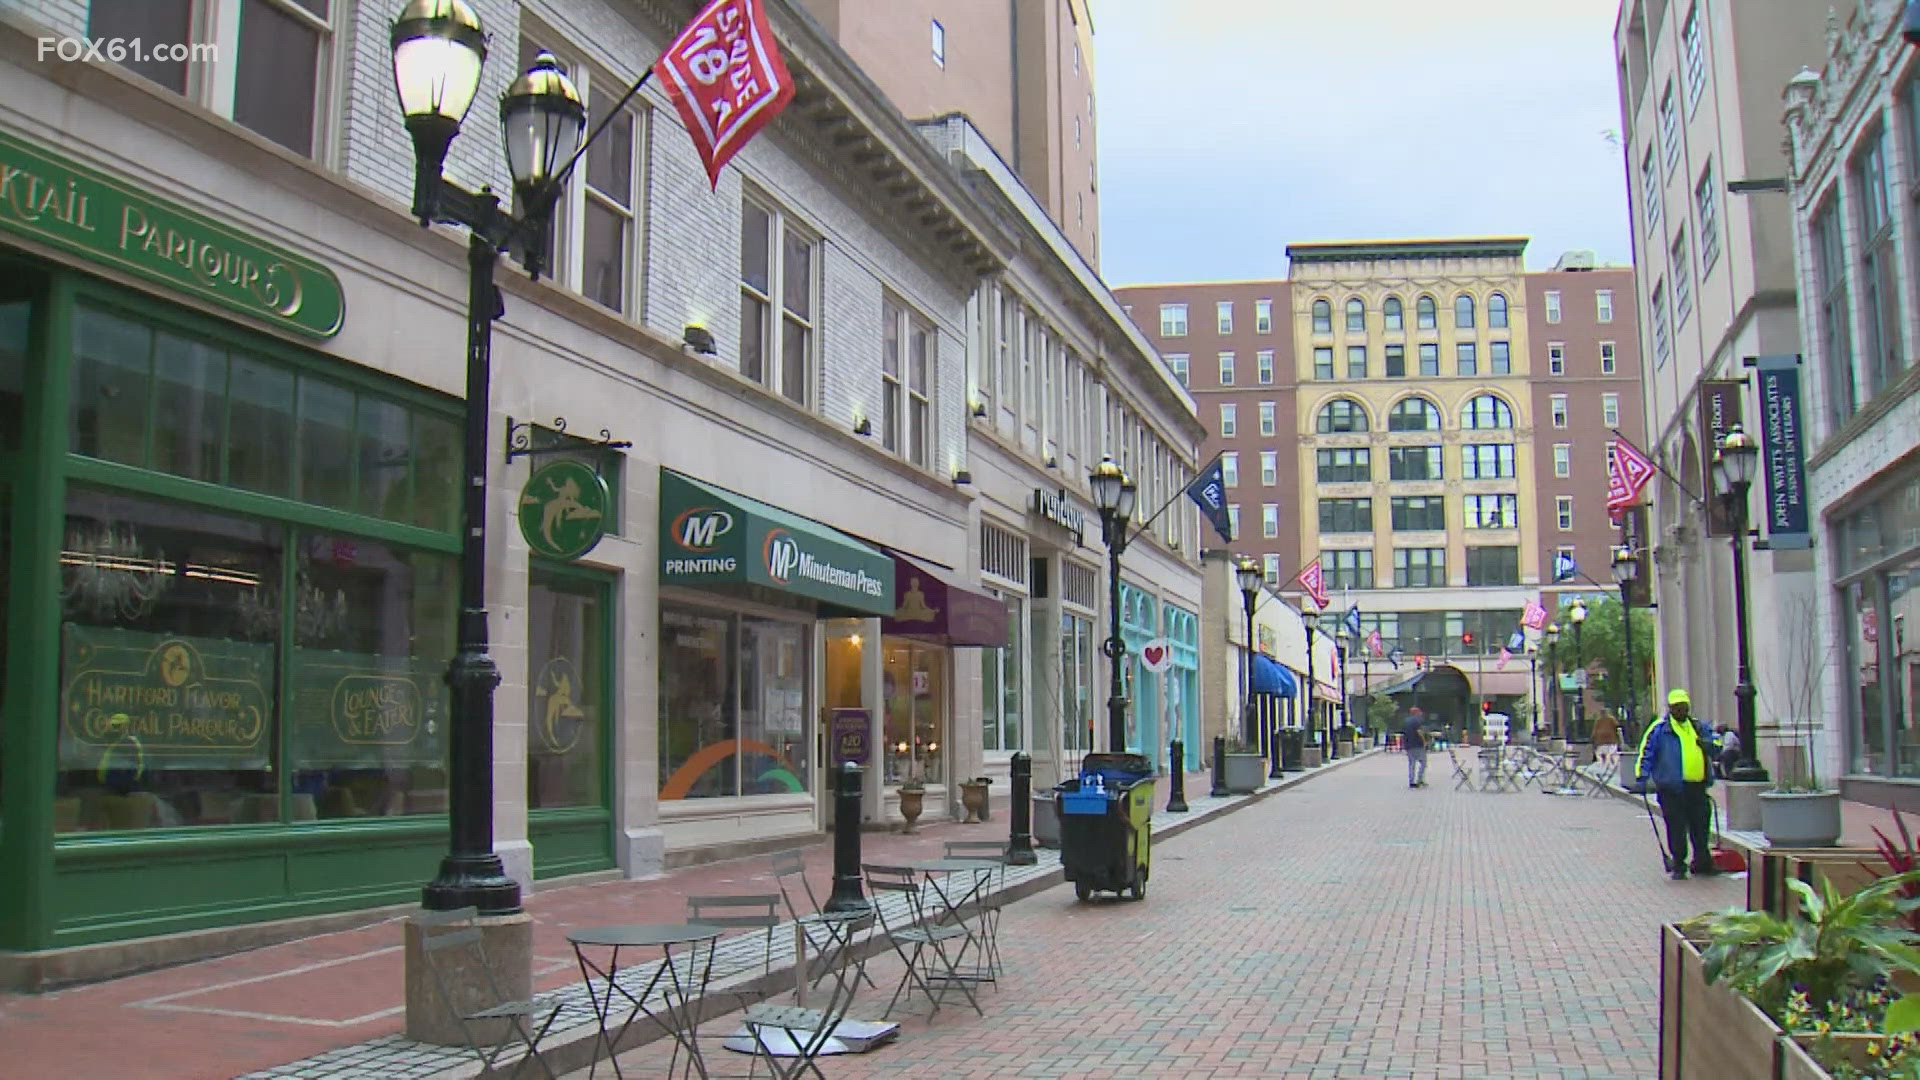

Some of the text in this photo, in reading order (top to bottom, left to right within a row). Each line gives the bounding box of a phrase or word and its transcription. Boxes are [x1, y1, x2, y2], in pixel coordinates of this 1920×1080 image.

[665, 557, 737, 575] PRINTING
[798, 551, 857, 591] Minuteman
[856, 569, 883, 597] Press
